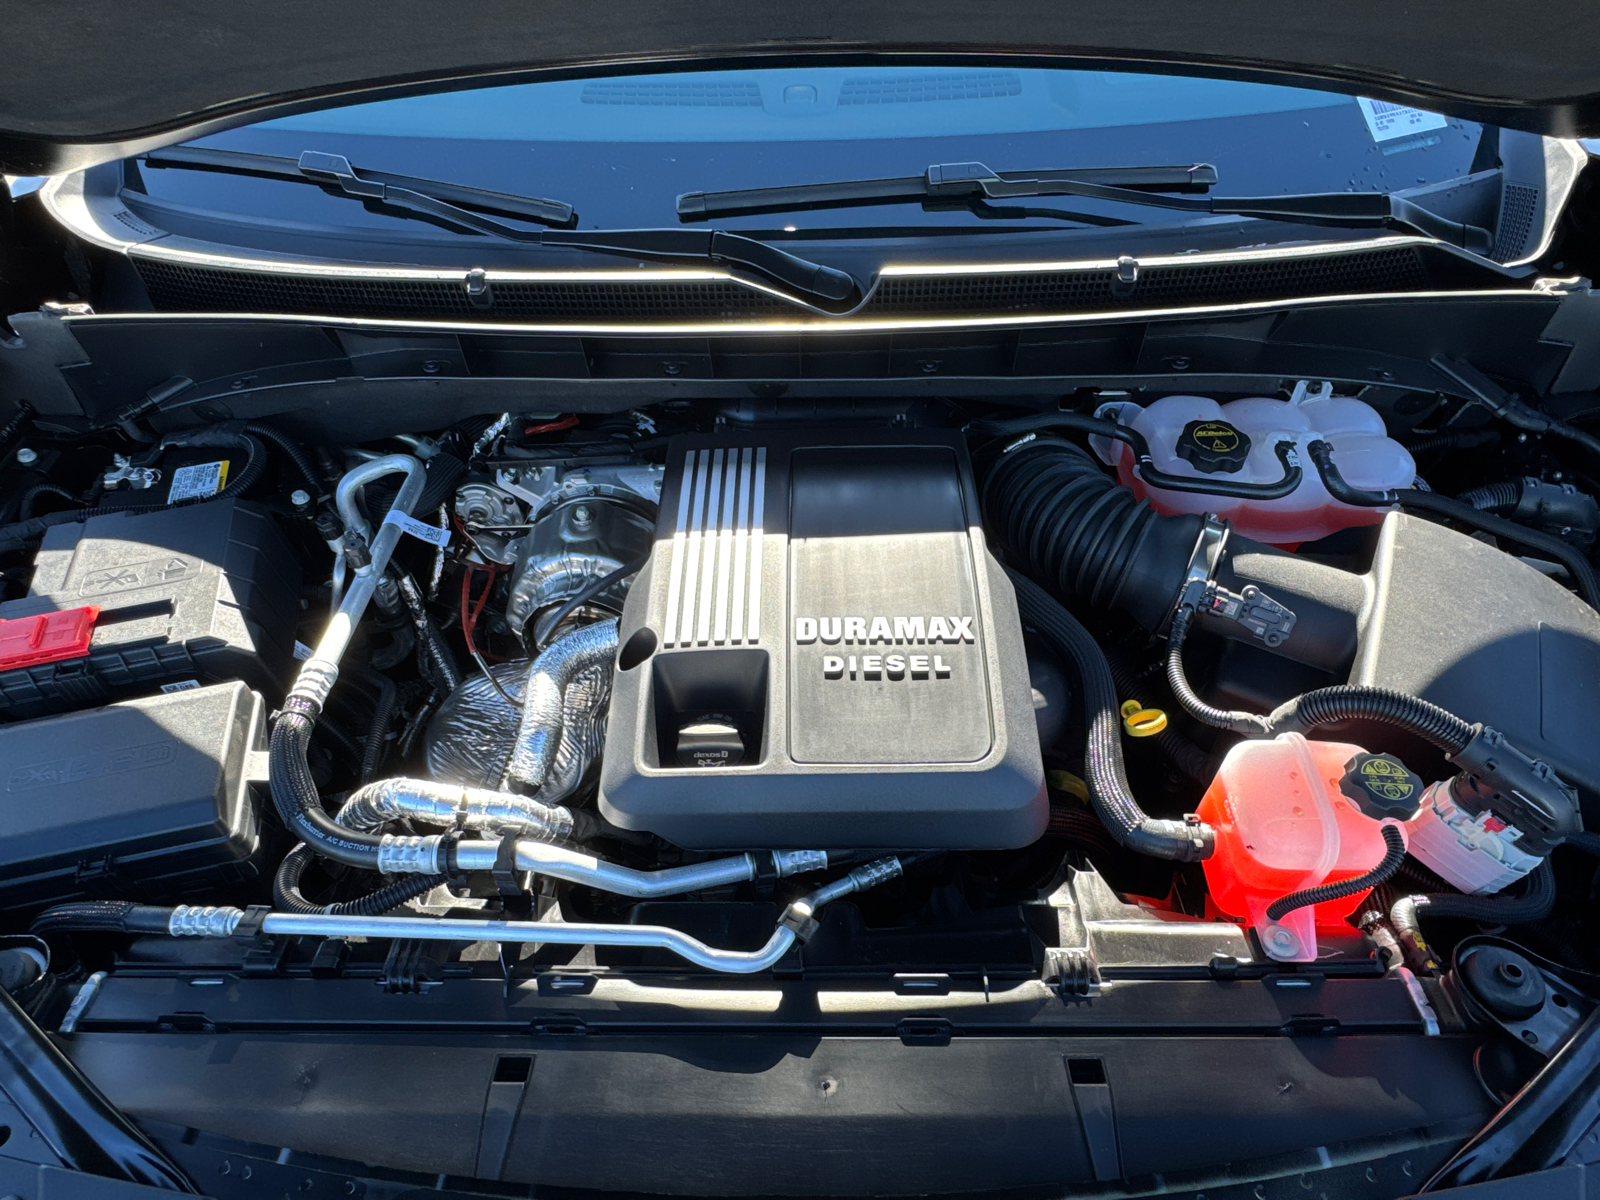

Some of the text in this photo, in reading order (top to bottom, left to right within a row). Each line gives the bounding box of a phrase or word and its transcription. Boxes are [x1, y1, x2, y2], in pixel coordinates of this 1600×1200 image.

[795, 616, 975, 645] DURAMAX
[823, 655, 951, 679] DIESEL
[338, 840, 370, 852] SUCTION
